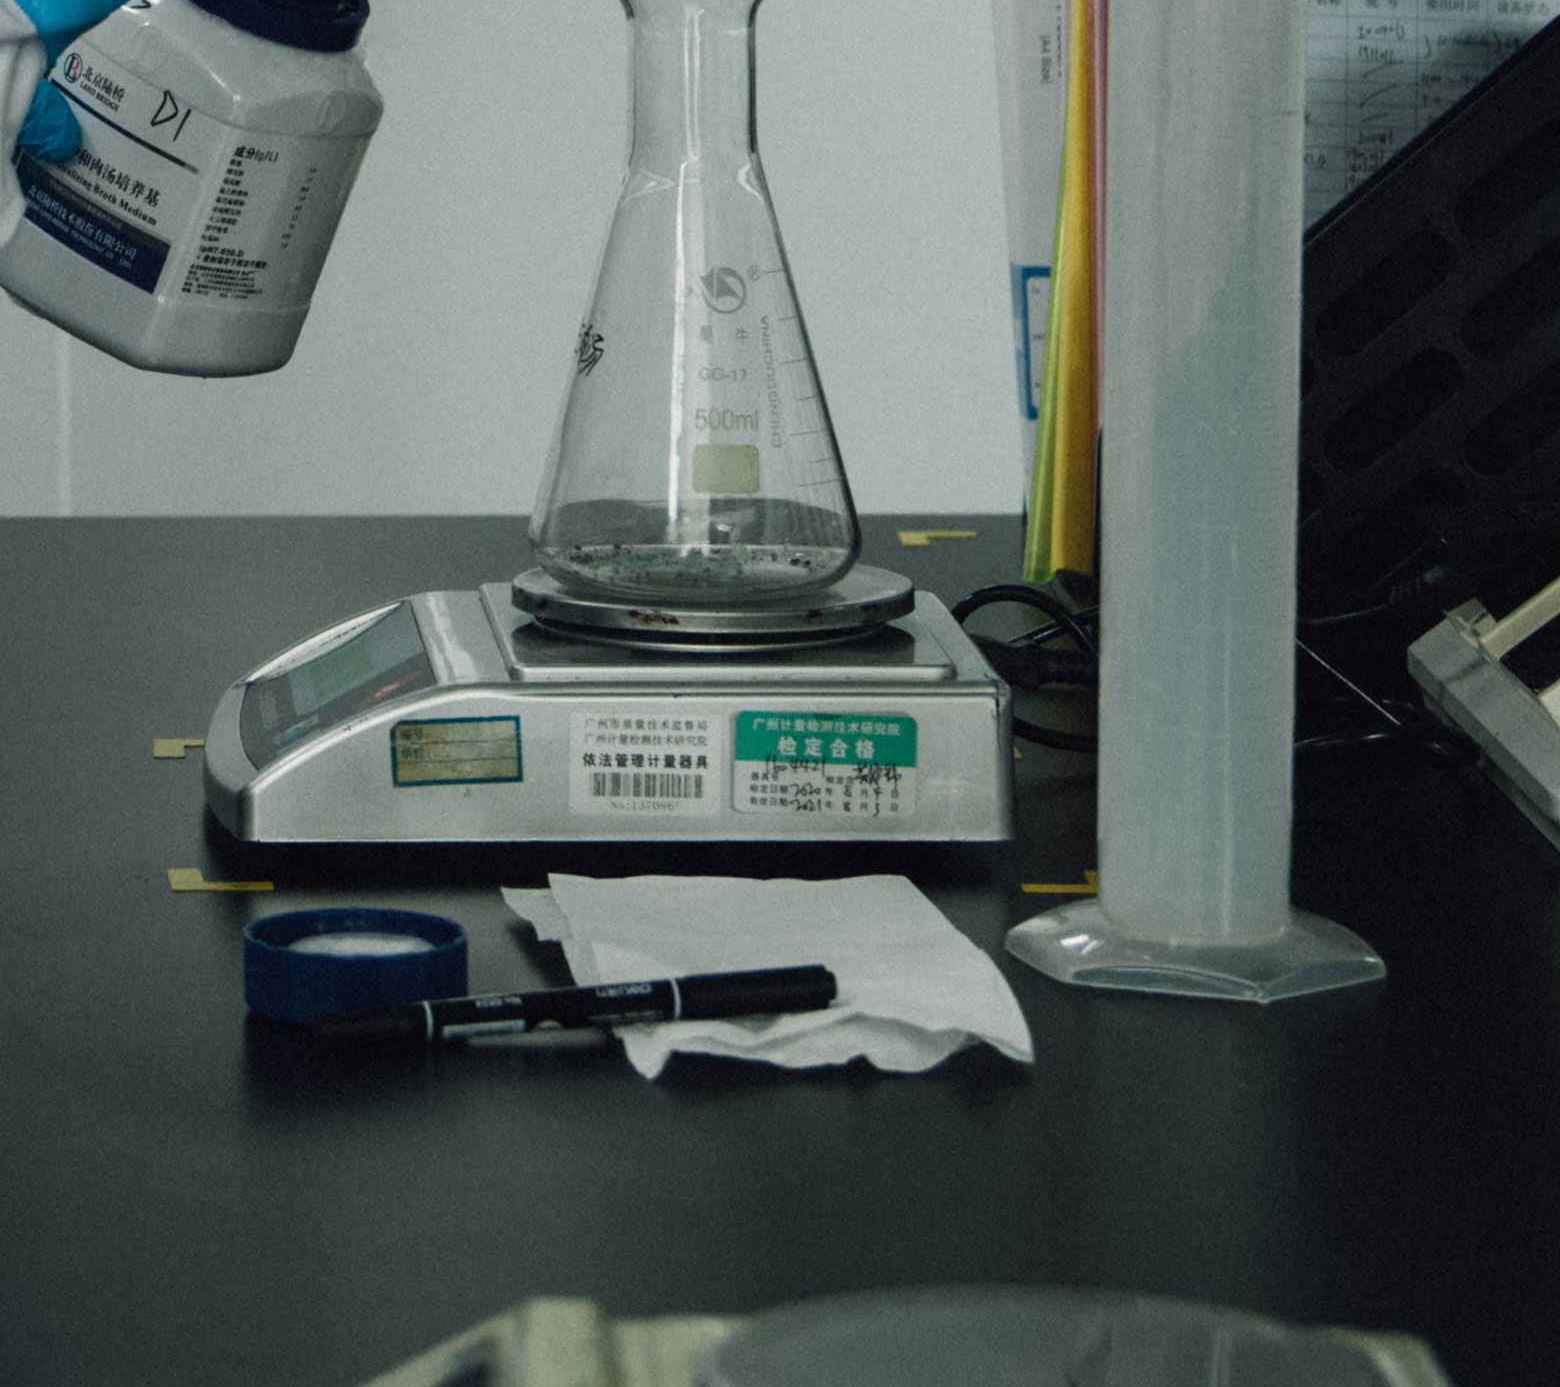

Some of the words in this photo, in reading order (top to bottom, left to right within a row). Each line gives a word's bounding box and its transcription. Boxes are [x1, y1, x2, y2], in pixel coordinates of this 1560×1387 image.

[81, 65, 125, 102] 北京陆桥
[150, 89, 192, 142] D1
[76, 147, 161, 208] 和肉汤培养基
[93, 184, 117, 205] Broth
[119, 198, 157, 227] Medium
[698, 367, 747, 383] GG-17
[694, 408, 760, 431] 500ml
[752, 717, 901, 736] 广州计量检测技术研究院
[584, 733, 709, 746] 广州计量检测技术研究院
[777, 735, 875, 759] 检定合格
[582, 752, 709, 769] 依法管理计量器具
